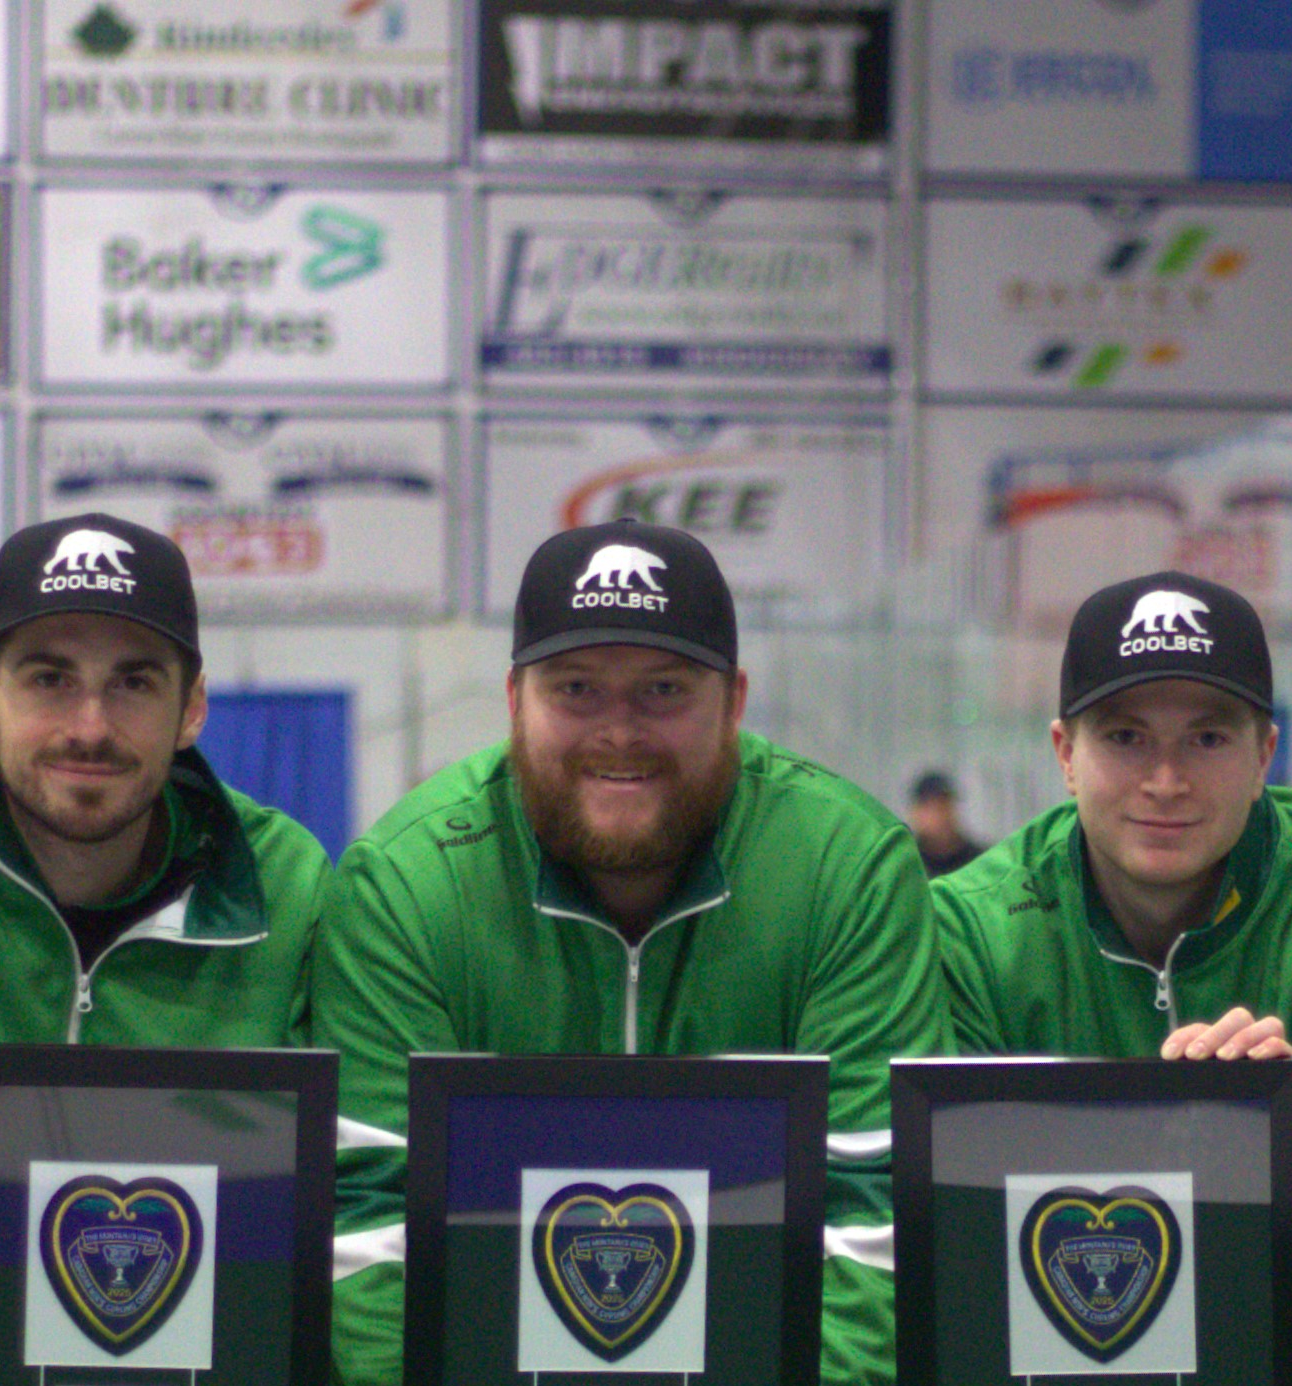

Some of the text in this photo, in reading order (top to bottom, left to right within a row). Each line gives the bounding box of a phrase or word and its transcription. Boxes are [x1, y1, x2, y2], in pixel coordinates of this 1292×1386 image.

[503, 15, 872, 127] IMPACT
[99, 238, 281, 292] Baker
[99, 309, 336, 369] Hughes
[40, 573, 137, 595] COOLBET
[572, 591, 669, 613] COOLBET
[1119, 635, 1214, 657] COOLBET
